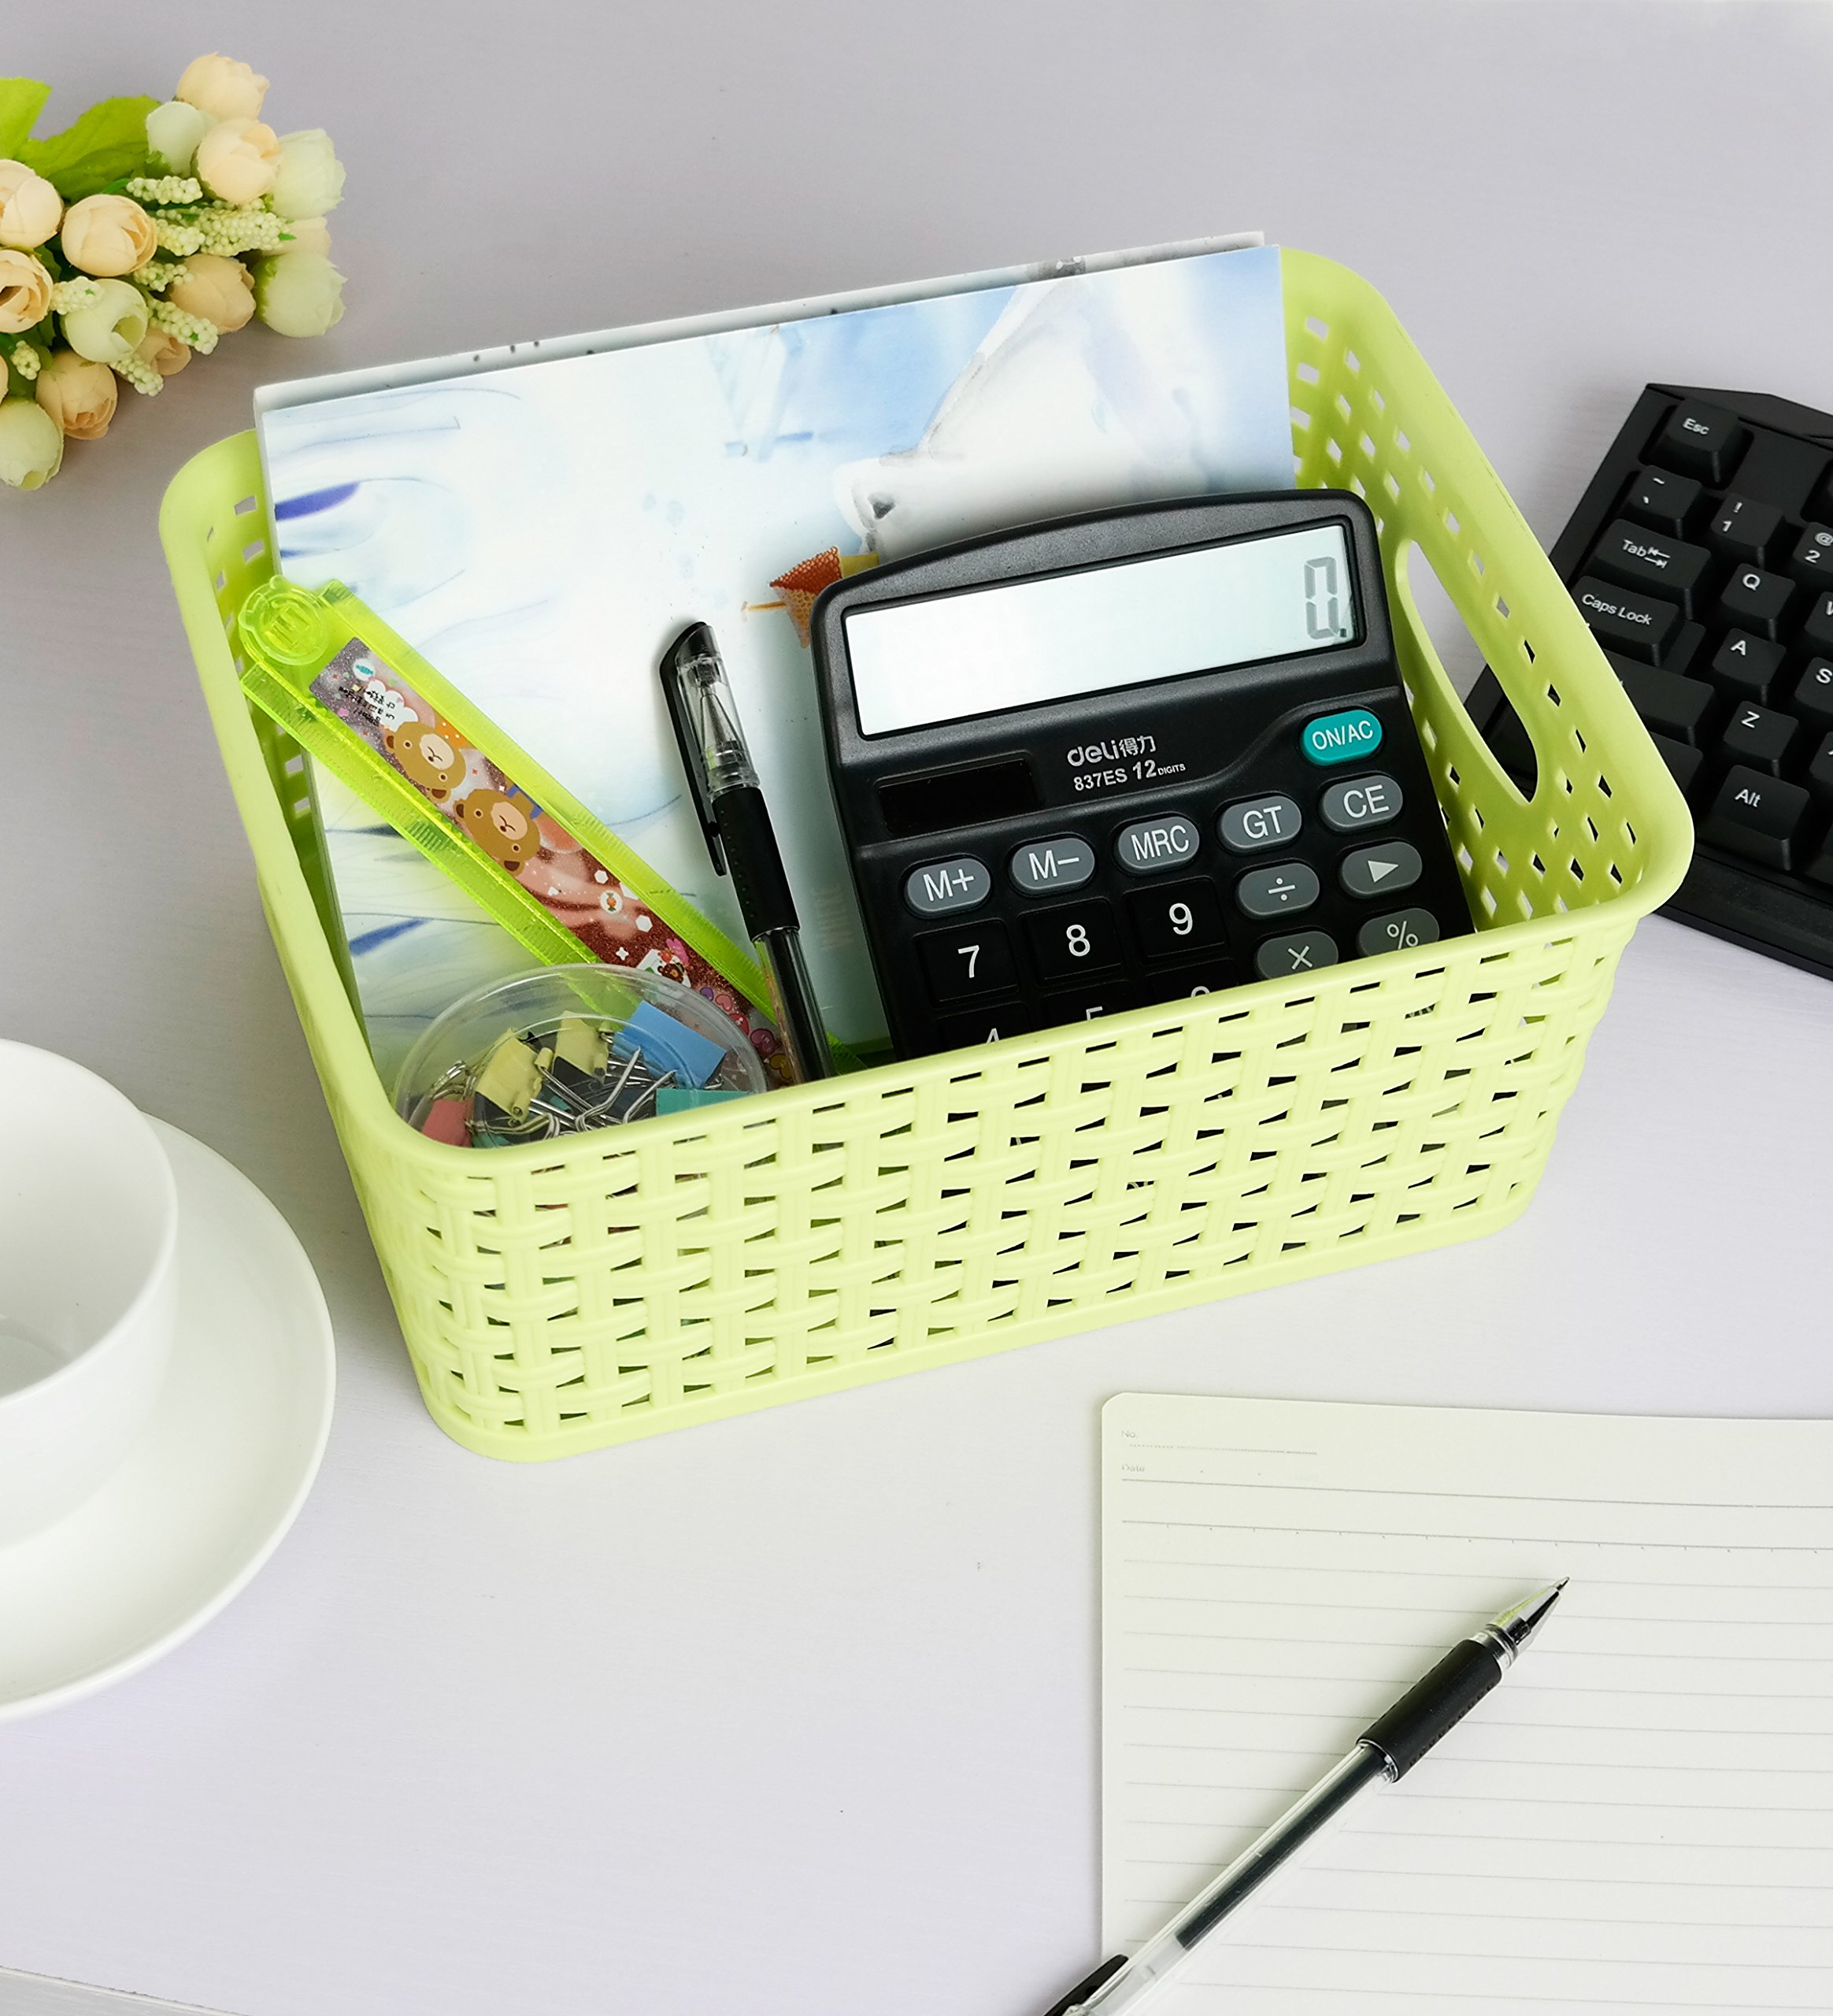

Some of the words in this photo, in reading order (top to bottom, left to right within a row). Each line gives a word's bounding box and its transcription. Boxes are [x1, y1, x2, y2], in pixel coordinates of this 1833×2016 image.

[1683, 417, 1709, 435] Esc
[1722, 520, 1732, 532] 1
[1623, 539, 1646, 558] Tab
[1805, 550, 1821, 564] 2
[1742, 573, 1761, 591] Q
[1581, 594, 1616, 617] Caps
[1617, 606, 1653, 625] Lock
[1730, 639, 1747, 656] A
[1816, 668, 1833, 684] S
[1311, 719, 1374, 750] ON/AC
[1741, 710, 1761, 728] Z
[1073, 768, 1128, 791] 837ES
[1132, 759, 1157, 780] 12
[1157, 763, 1187, 776] DIGITS
[1343, 784, 1390, 818] CE
[1734, 788, 1761, 808] Alt
[1242, 805, 1283, 840] GT
[1131, 825, 1190, 862] MRC
[923, 869, 975, 901] M+
[1168, 902, 1193, 936] 9
[1066, 924, 1091, 957] 8
[957, 944, 980, 979] 7
